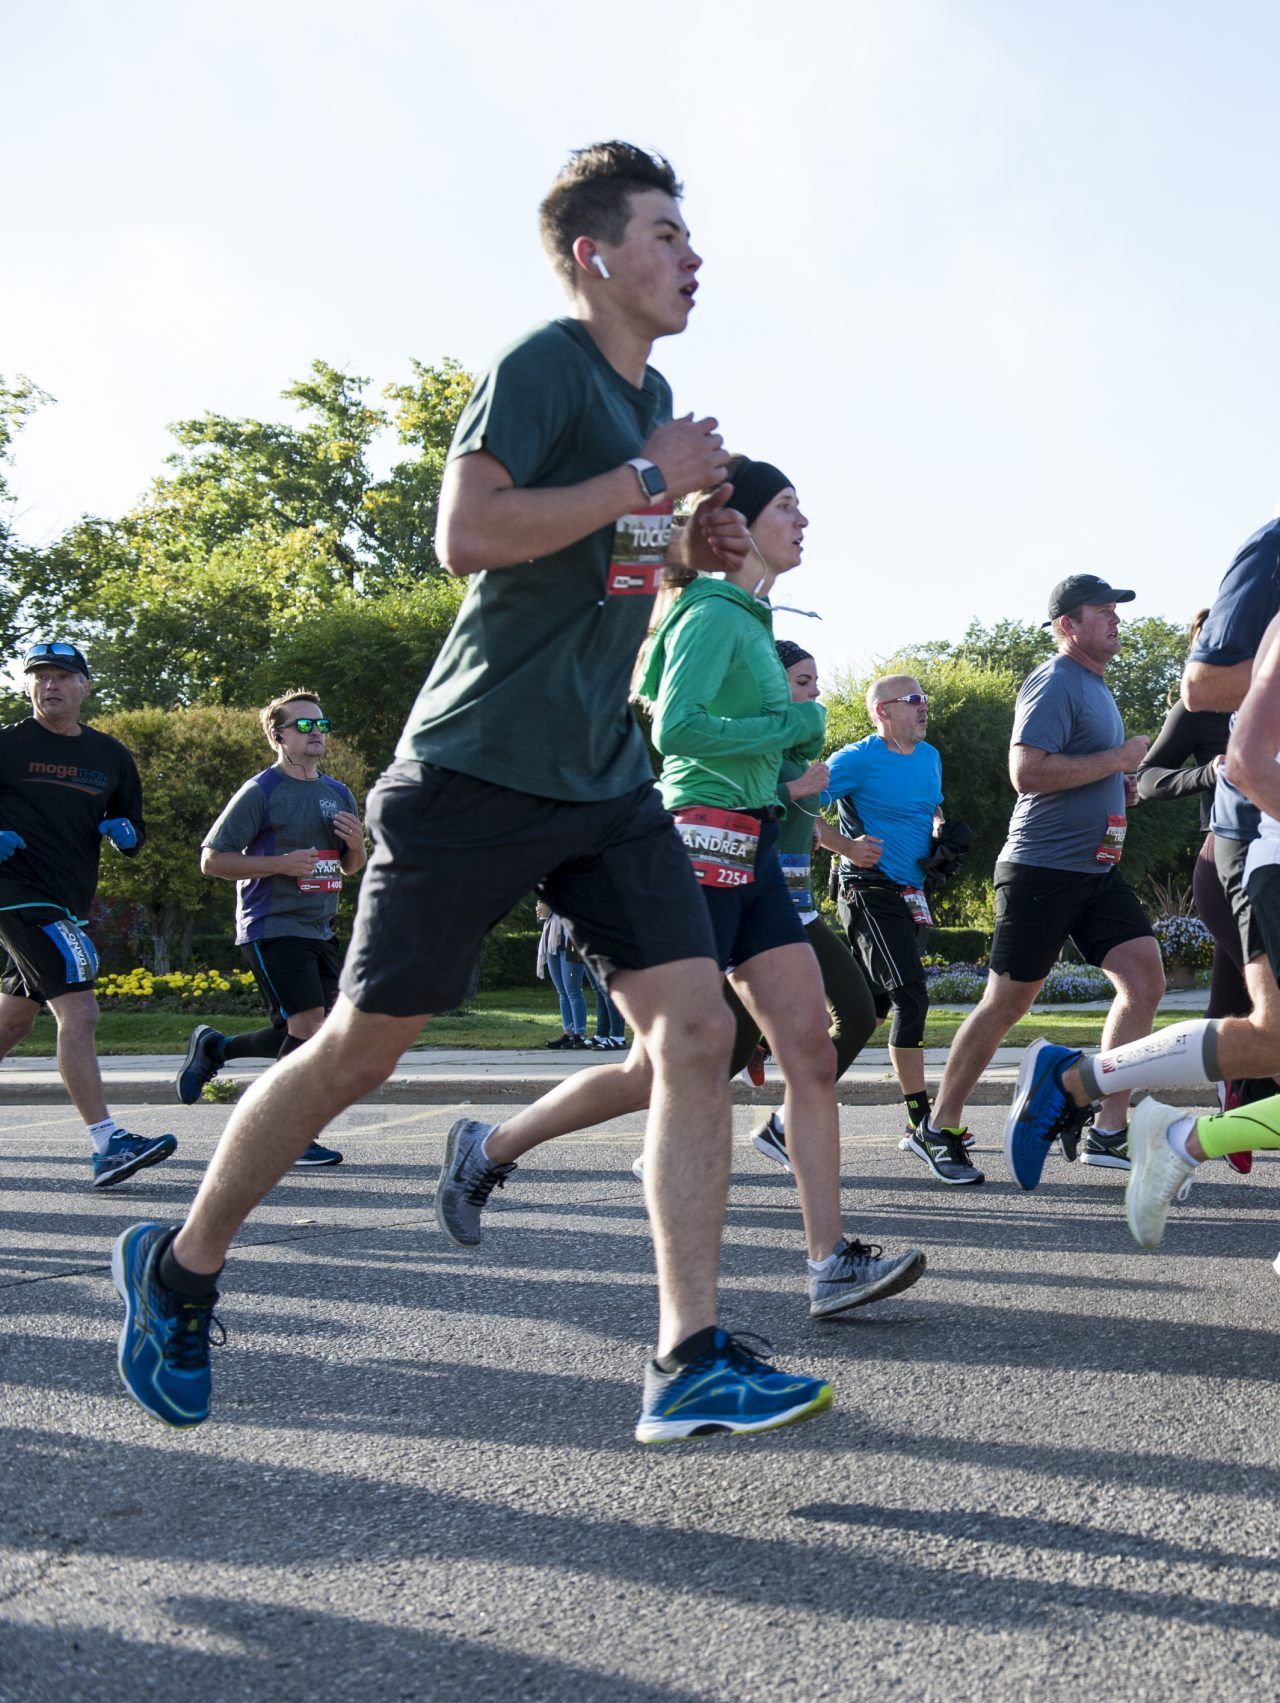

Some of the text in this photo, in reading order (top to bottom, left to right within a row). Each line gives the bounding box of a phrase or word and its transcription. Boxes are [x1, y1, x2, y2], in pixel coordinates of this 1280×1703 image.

[683, 834, 747, 857] ANDREA
[717, 868, 748, 886] 2254
[68, 933, 88, 966] DANO
